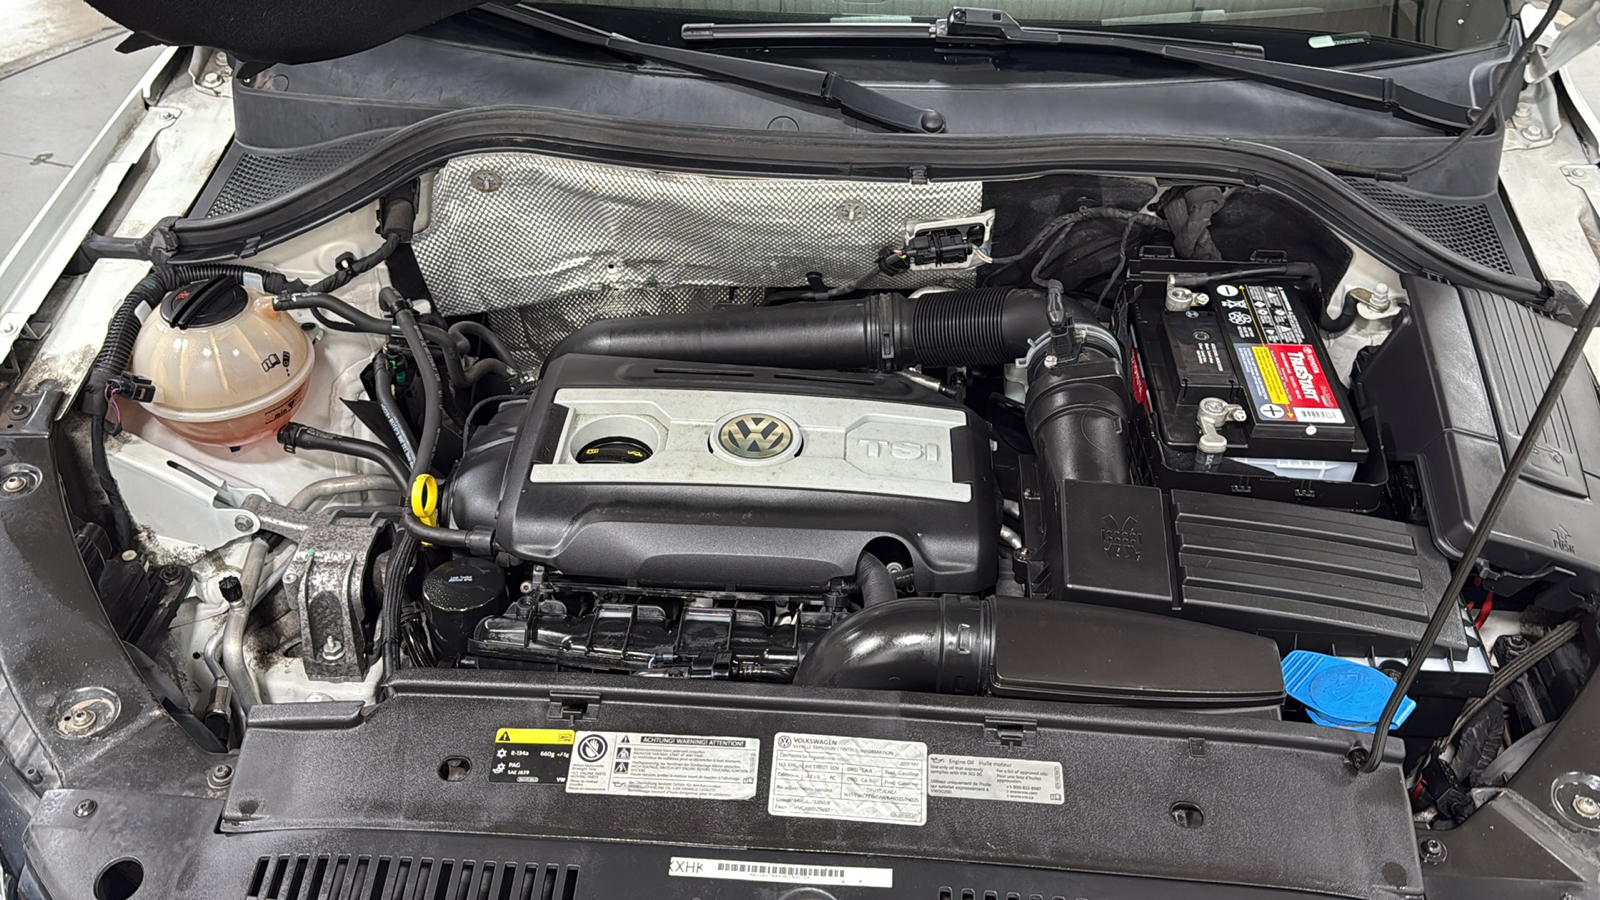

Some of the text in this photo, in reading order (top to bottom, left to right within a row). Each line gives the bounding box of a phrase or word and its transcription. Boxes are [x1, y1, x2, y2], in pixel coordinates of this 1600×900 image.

[1306, 353, 1321, 374] TOYOTA
[857, 438, 941, 462] TSI
[643, 736, 675, 744] ACHTUNG!
[793, 737, 838, 746] VOLKSWAGEN
[949, 758, 966, 766] Engine
